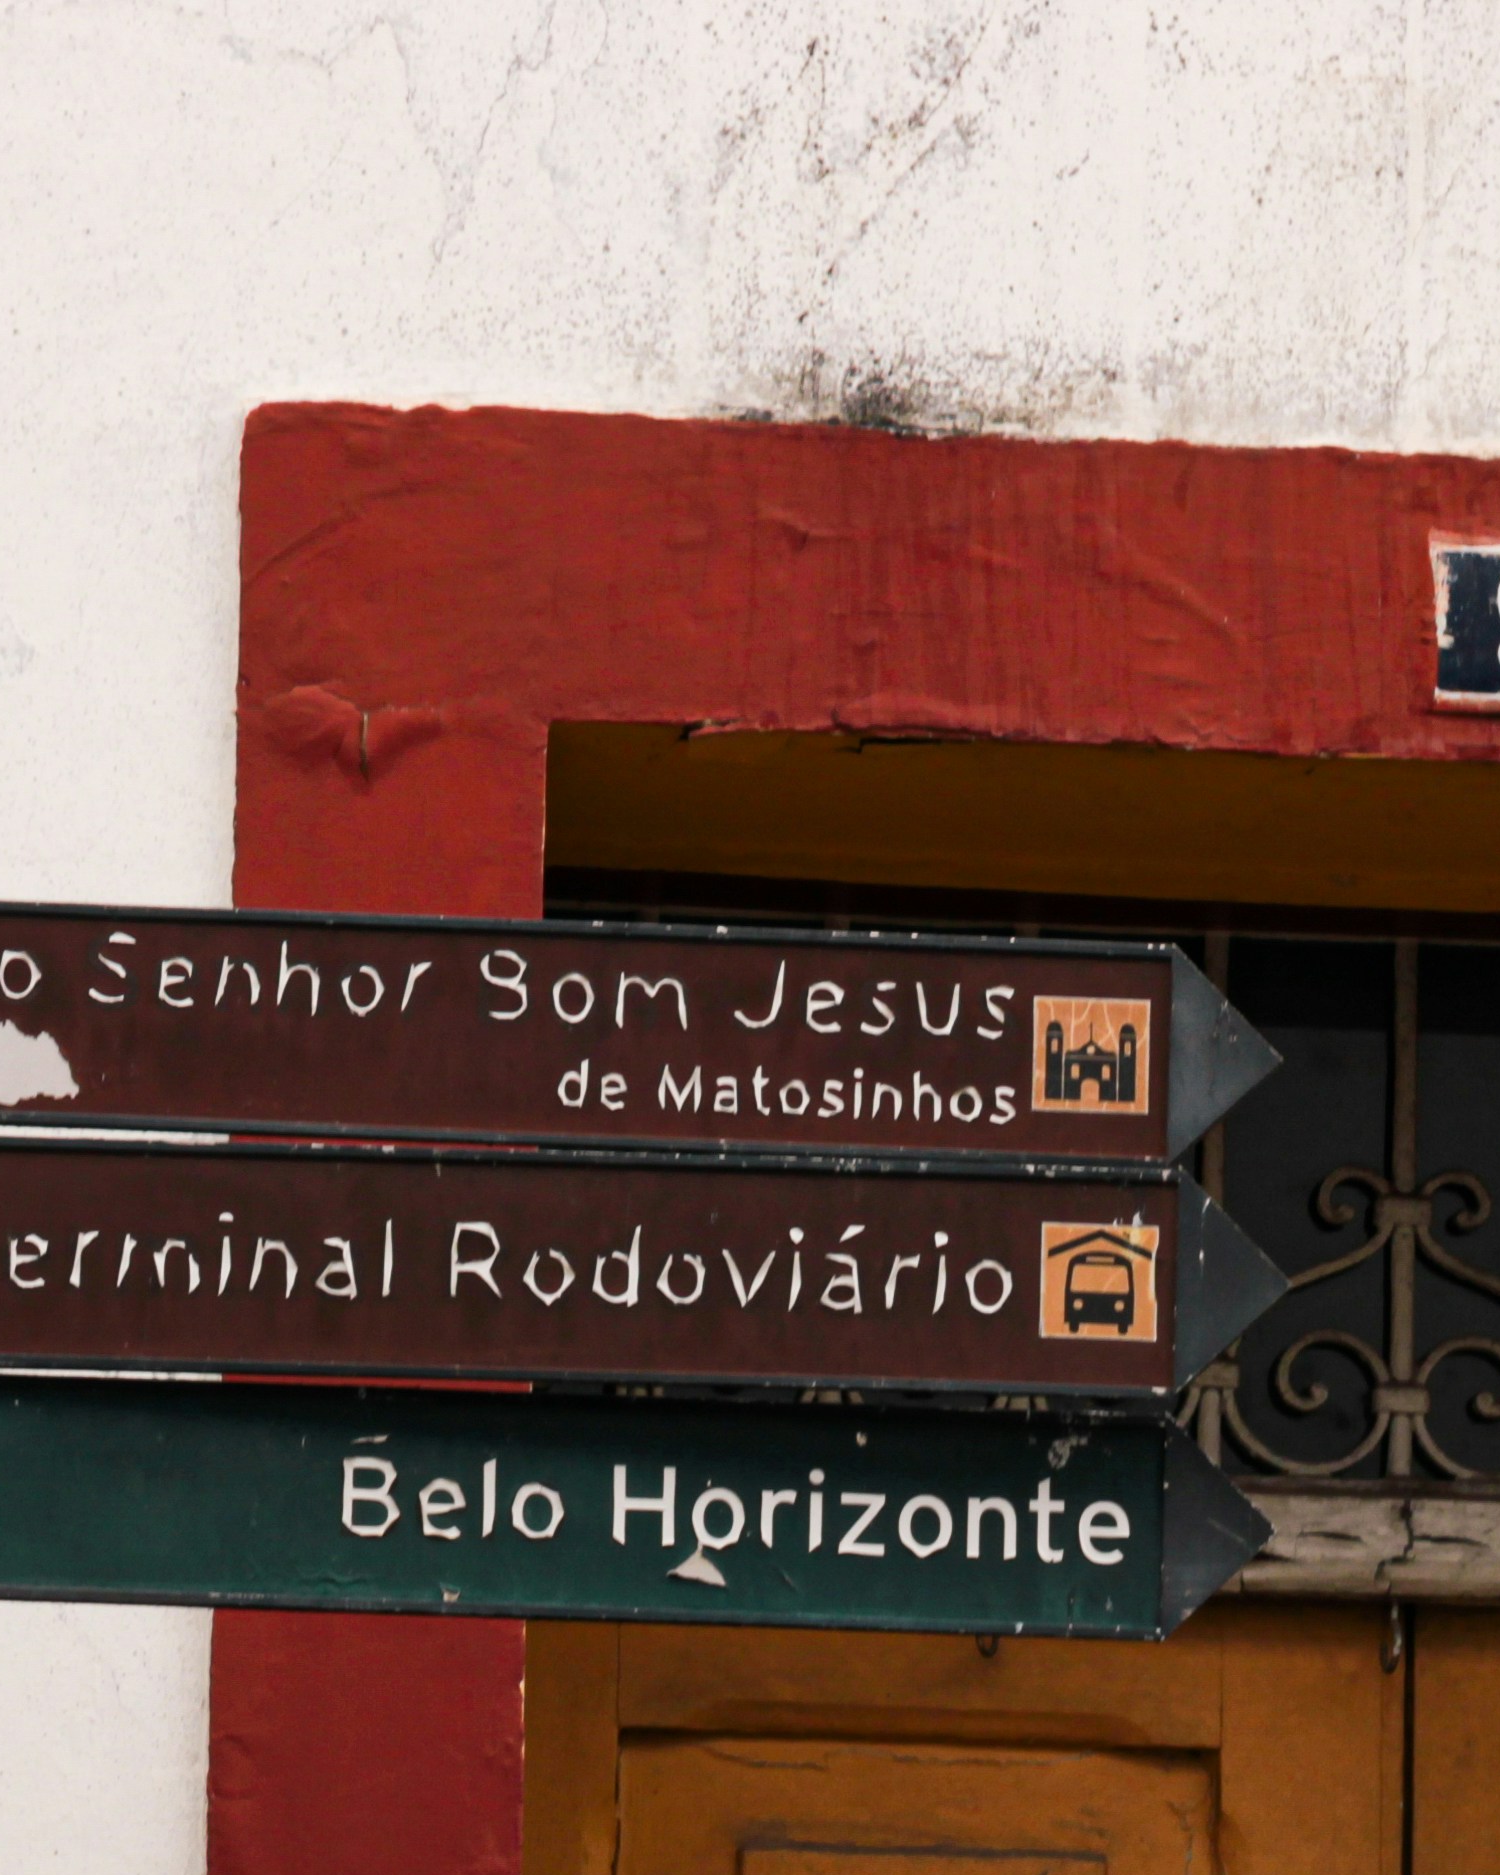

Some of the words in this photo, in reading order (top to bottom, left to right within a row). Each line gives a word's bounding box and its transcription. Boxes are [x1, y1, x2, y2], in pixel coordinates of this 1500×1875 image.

[88, 931, 432, 1017] Senhor
[734, 960, 1015, 1040] Jesus
[557, 1058, 628, 1111] de
[657, 1064, 1016, 1125] Matosinhos
[450, 1221, 1013, 1314] Rodoviário
[341, 1456, 565, 1540] Belo
[612, 1464, 1131, 1566] Horizonte
